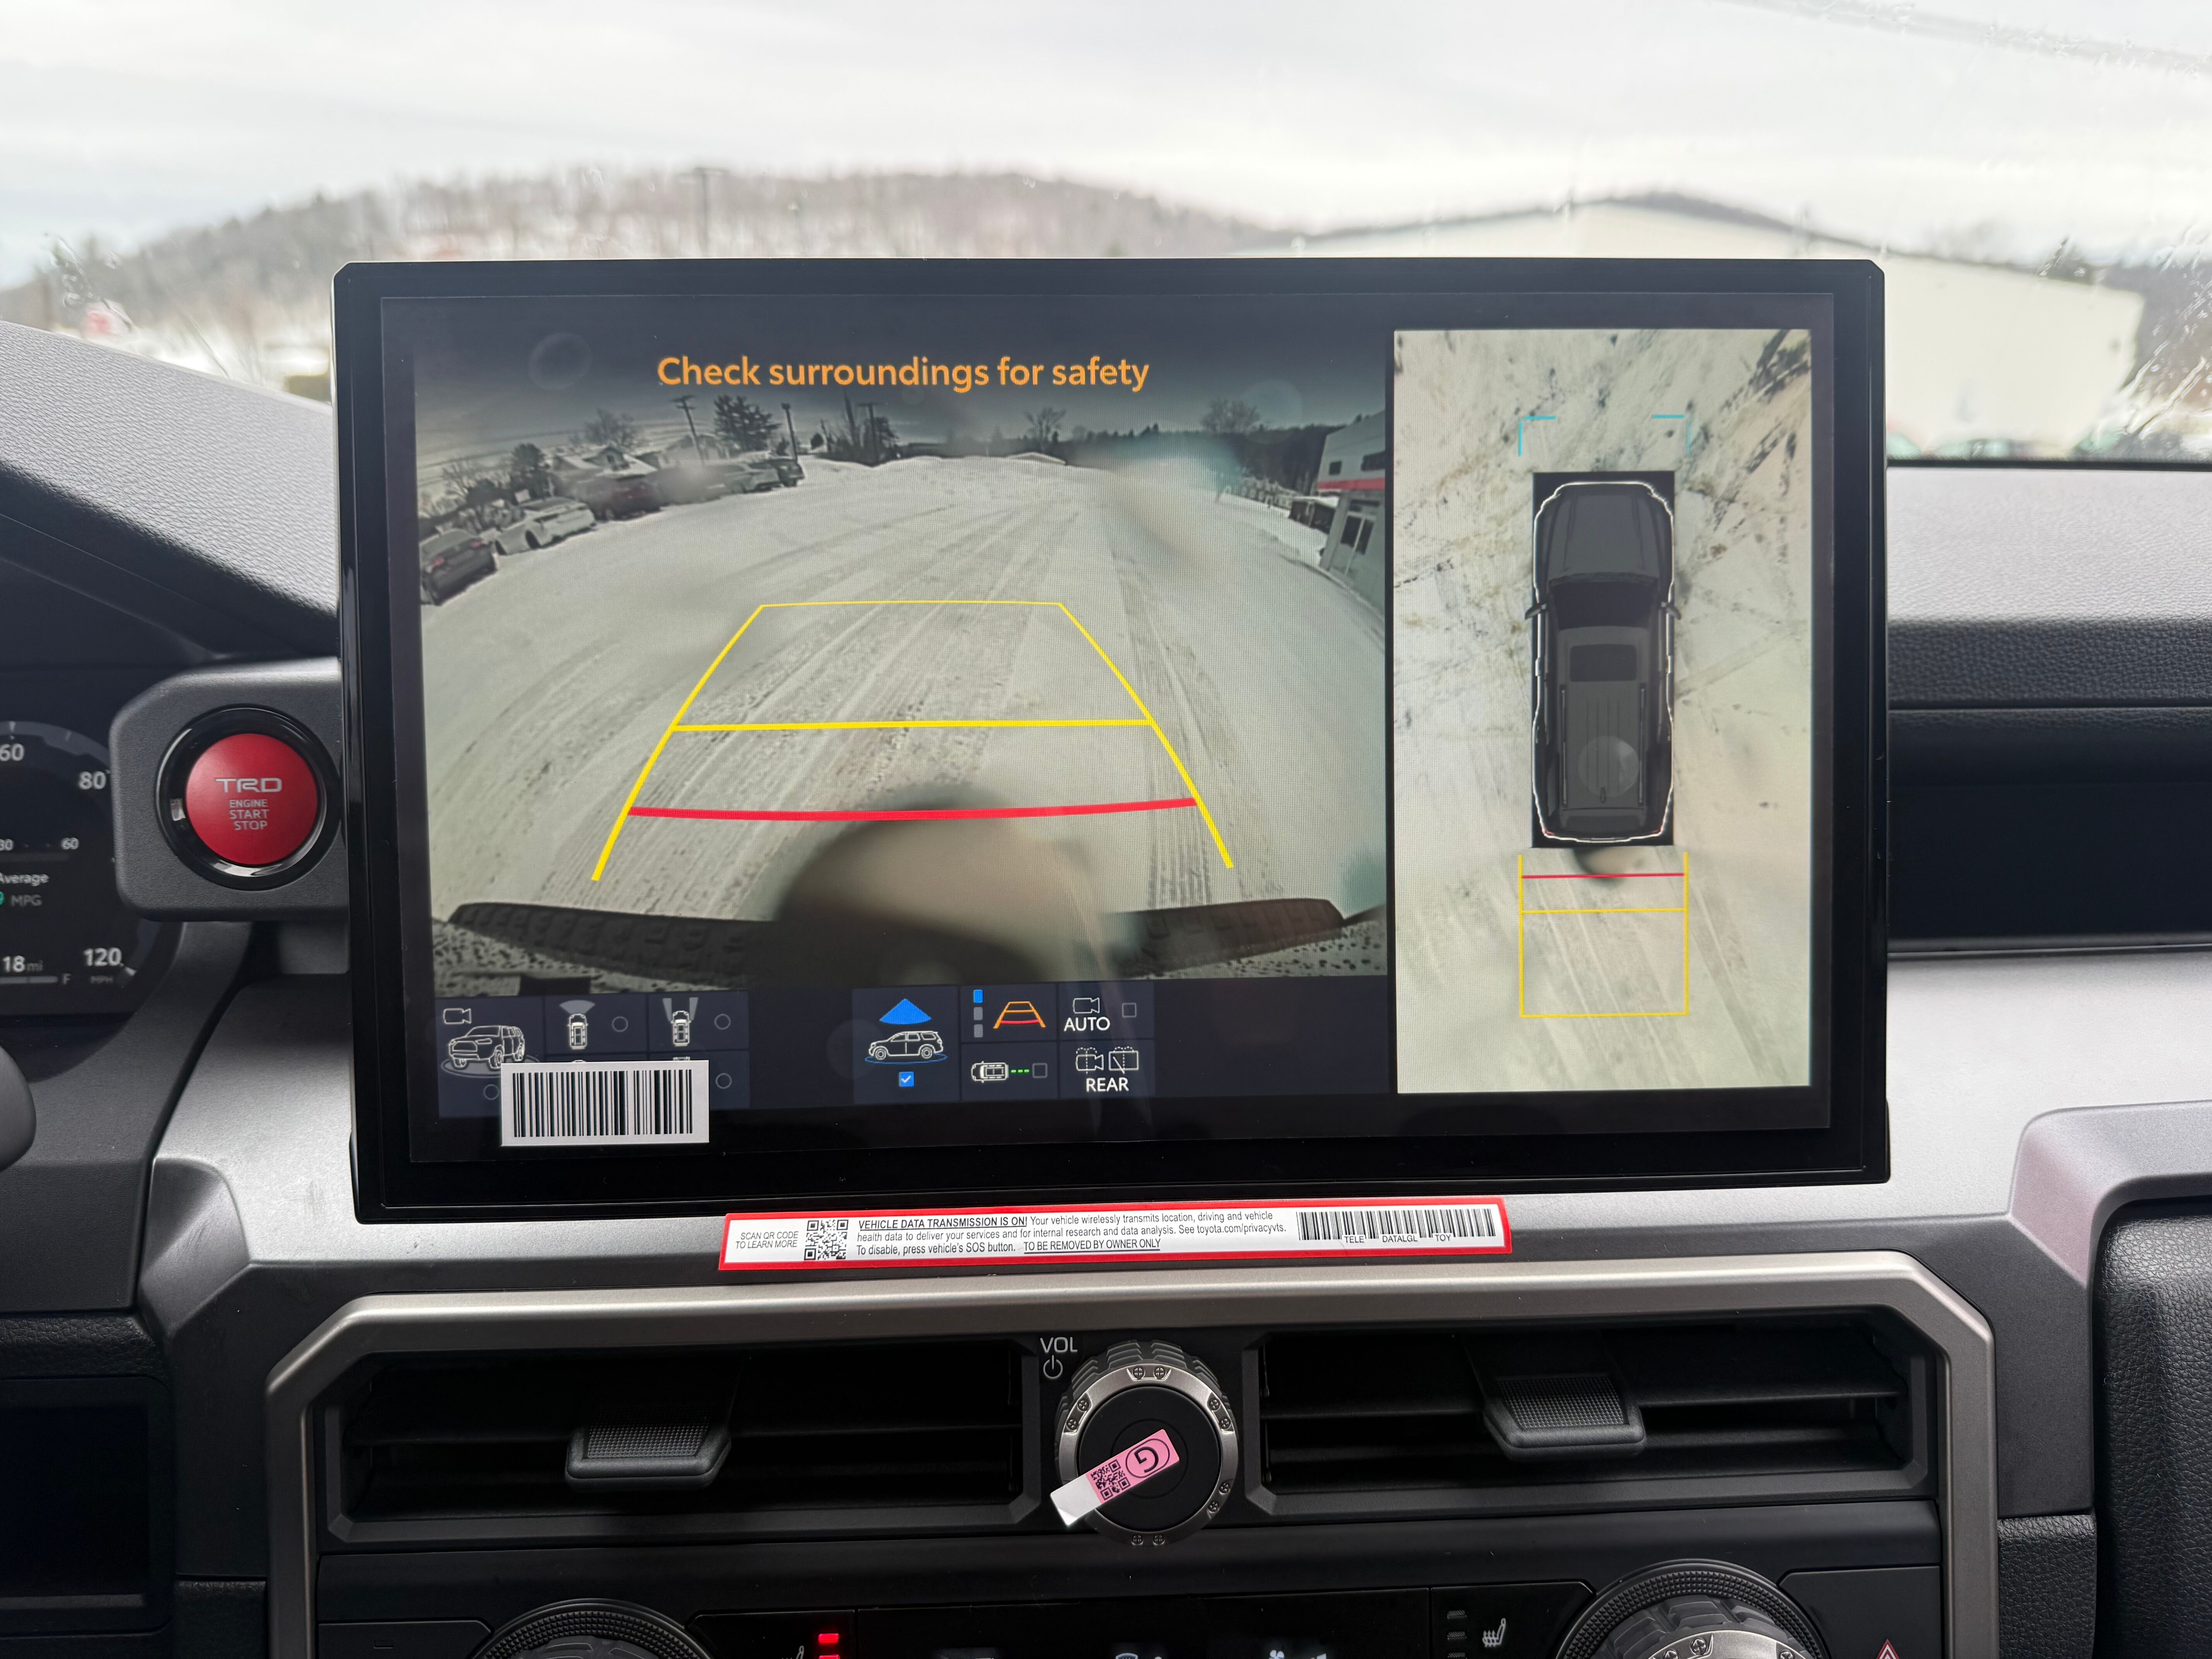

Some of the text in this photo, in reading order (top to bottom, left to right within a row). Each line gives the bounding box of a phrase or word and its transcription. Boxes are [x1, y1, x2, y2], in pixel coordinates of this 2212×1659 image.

[658, 356, 1150, 393] Check surroundings for safety
[0, 743, 24, 762] 60
[79, 771, 106, 790] 80
[215, 778, 282, 793] TRD
[229, 799, 268, 808] ENGINE
[229, 809, 270, 819] START
[234, 820, 268, 831] STOP
[61, 838, 79, 850] 60
[0, 872, 50, 886] Average
[11, 894, 42, 907] MPG
[3, 955, 25, 973] 18
[83, 947, 122, 967] 120
[1064, 1017, 1111, 1032] AUTO
[1086, 1077, 1129, 1092] REAR
[859, 1211, 1273, 1229] VEHICLE DATA TRANSMISSION IS ON! Your vehicle wirelessly transmits location, driving and vehicle
[857, 1223, 1286, 1242] health data to deliver your services and for internal research and data analysis. See toyota.com/privacyvts.
[1382, 1235, 1418, 1243] DATALGL
[736, 1240, 798, 1249] TO LEARN MORE
[857, 1242, 1016, 1256] To disable, press vehicle's SOS button.
[1024, 1238, 1161, 1251] TO BE REMOVED BY OWNER ONLY
[1040, 1337, 1078, 1353] VOL
